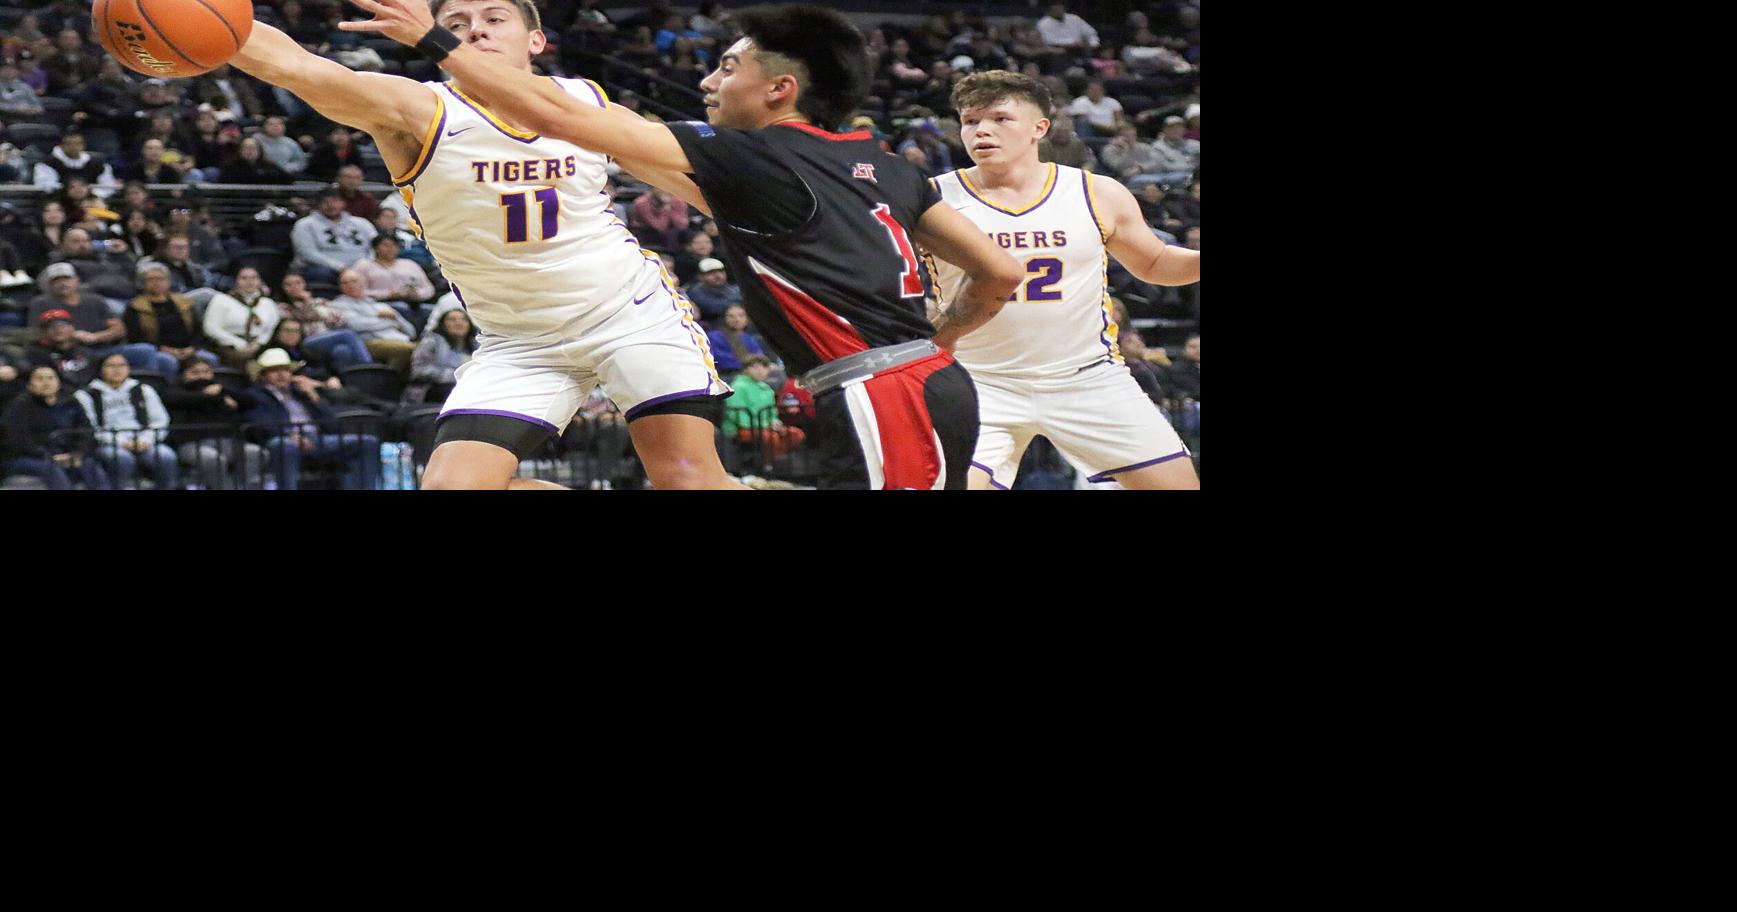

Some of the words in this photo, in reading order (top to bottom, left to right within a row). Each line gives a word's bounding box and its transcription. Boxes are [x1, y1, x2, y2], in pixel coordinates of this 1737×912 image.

[470, 154, 578, 184] TIGERS
[498, 185, 560, 245] 11
[869, 202, 925, 298] 1
[987, 229, 1069, 250] GERS
[1008, 255, 1064, 303] 2
